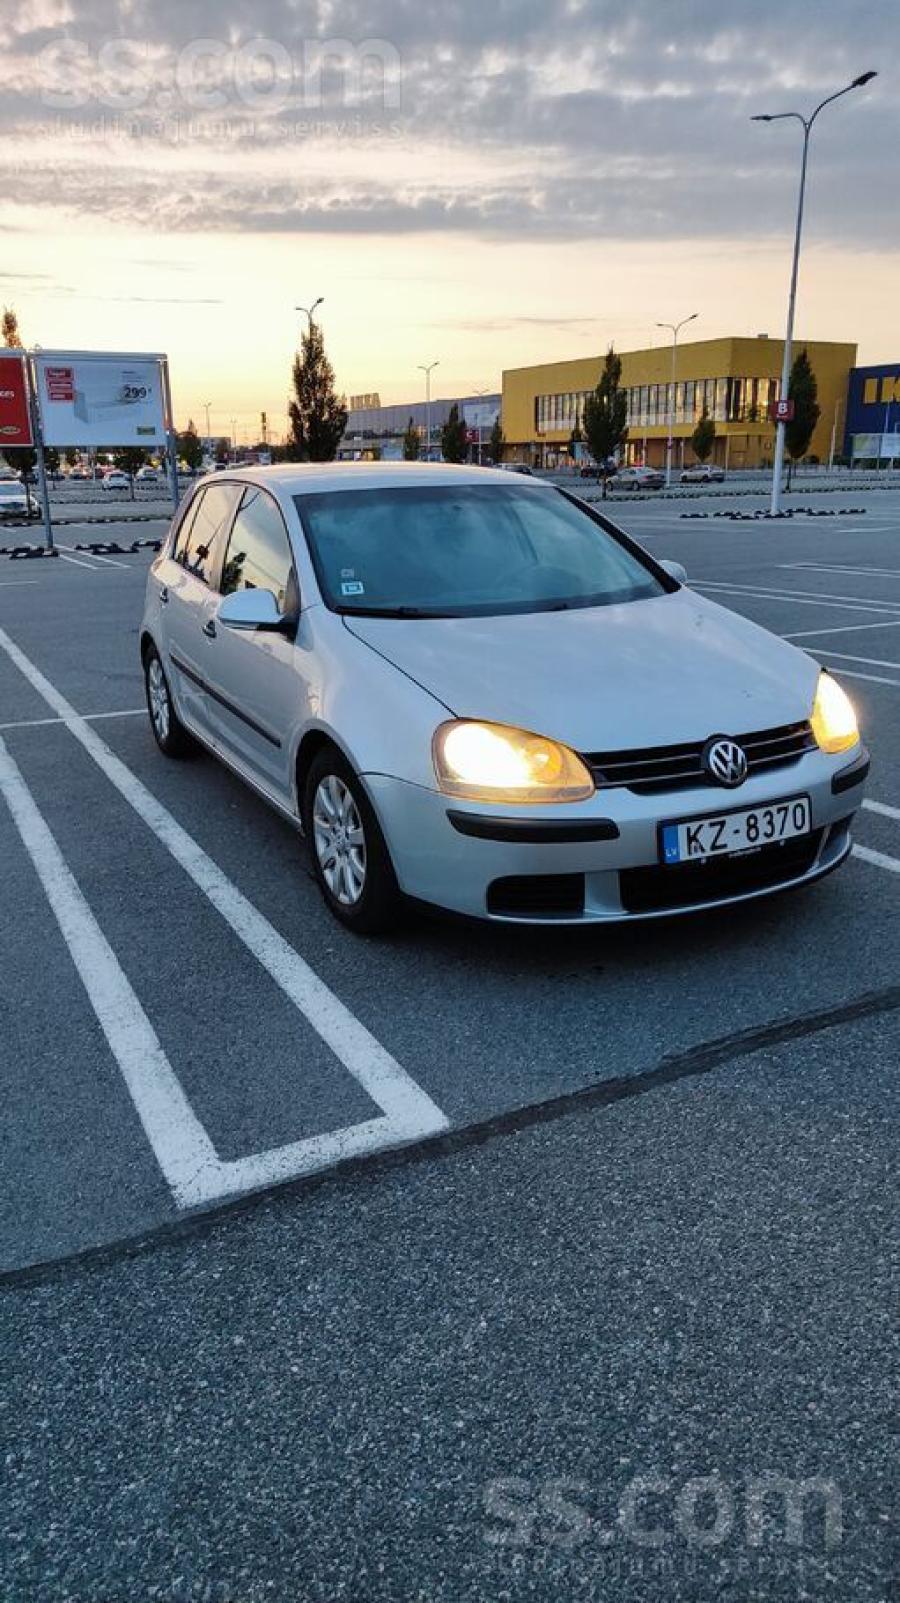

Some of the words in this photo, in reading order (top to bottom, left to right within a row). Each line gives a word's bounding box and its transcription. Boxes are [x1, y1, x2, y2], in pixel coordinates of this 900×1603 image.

[124, 386, 147, 399] 299
[778, 402, 788, 414] B
[686, 802, 806, 856] KZ-8370
